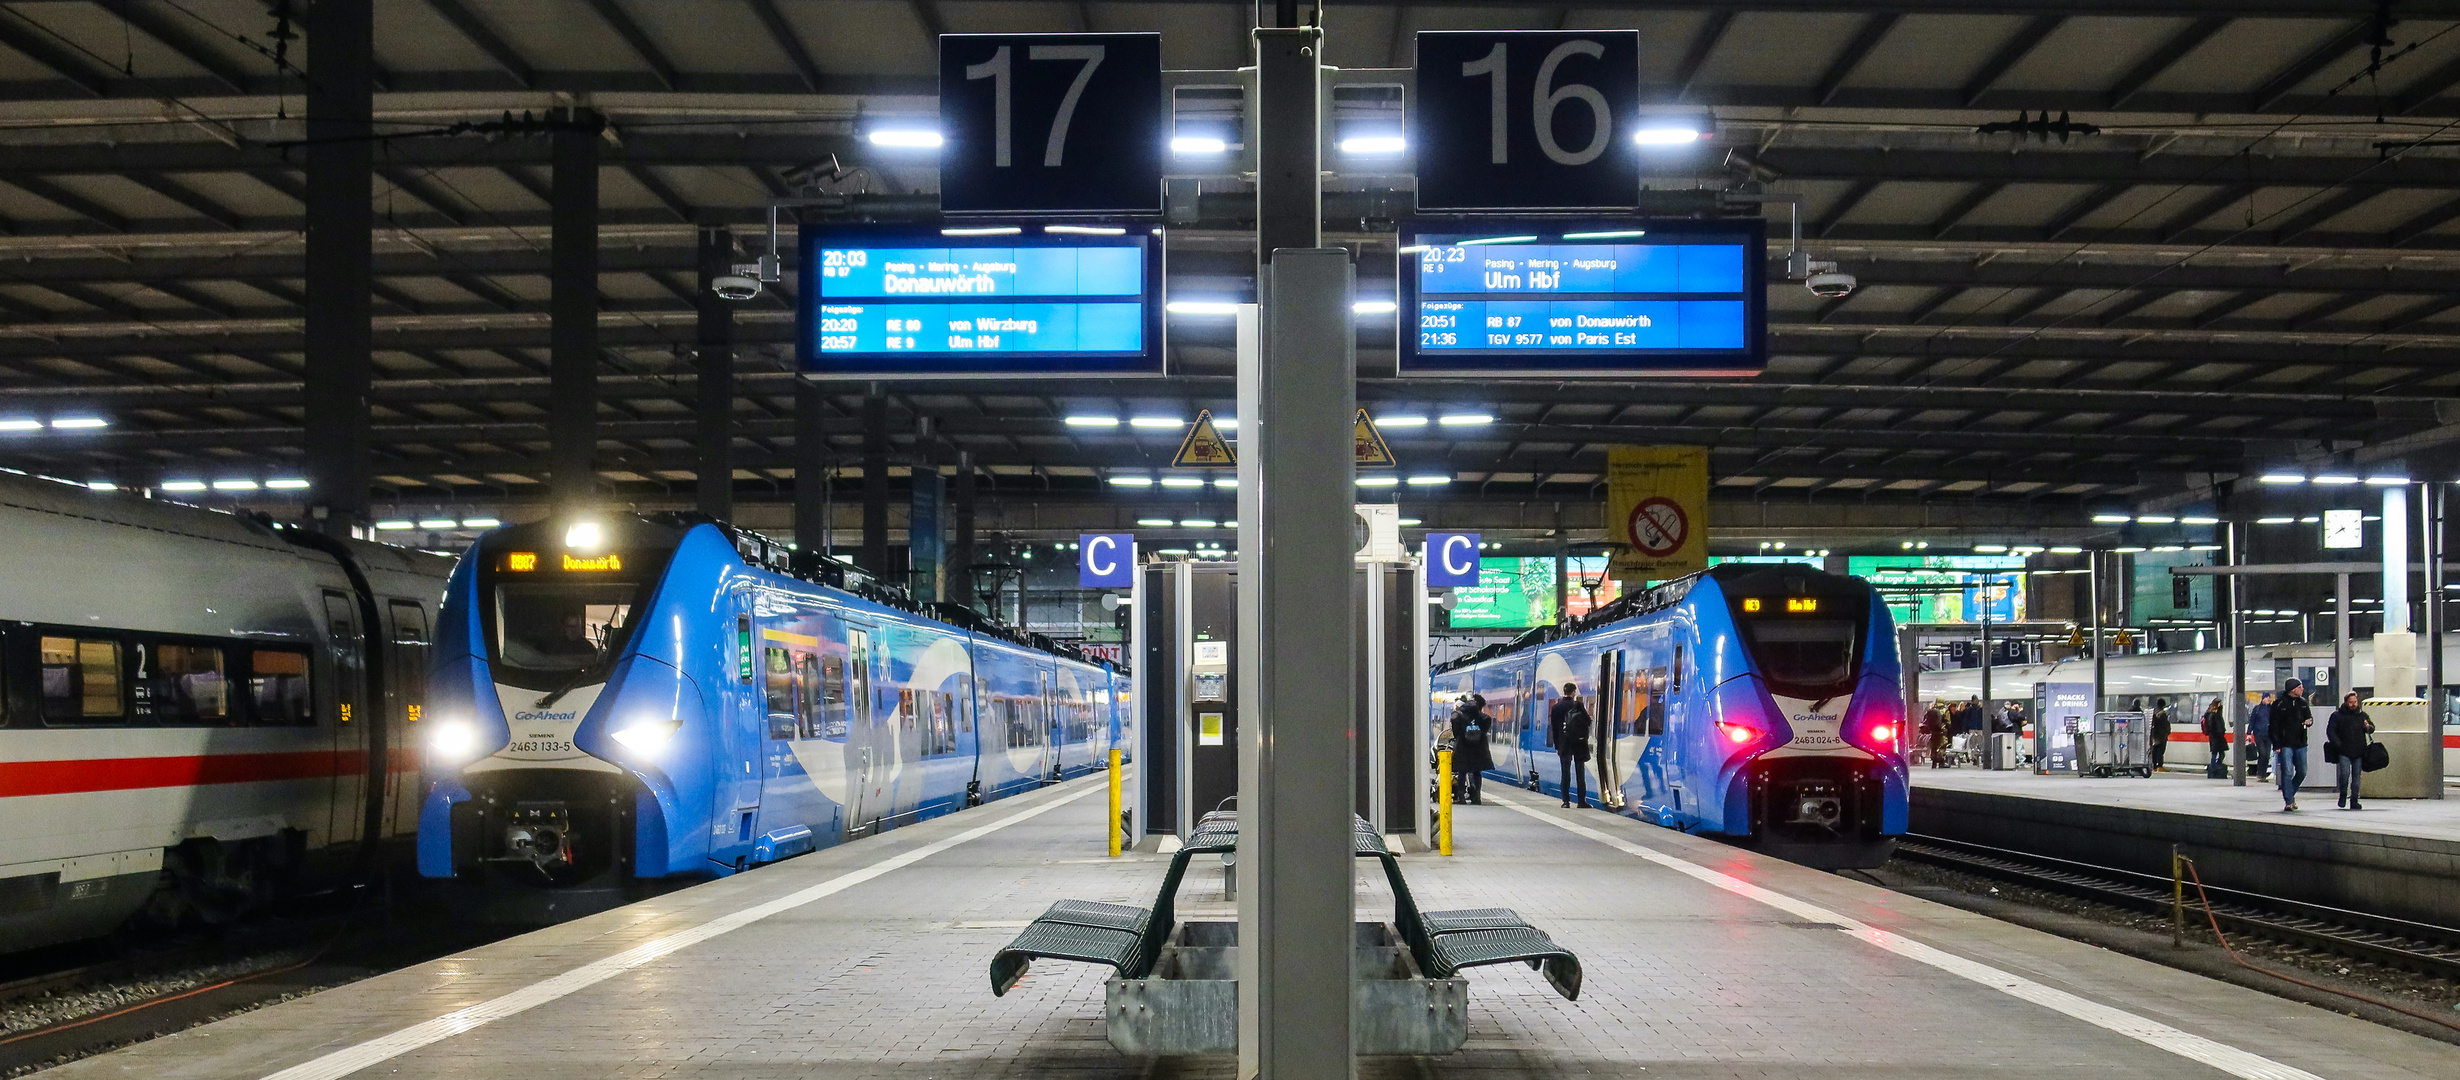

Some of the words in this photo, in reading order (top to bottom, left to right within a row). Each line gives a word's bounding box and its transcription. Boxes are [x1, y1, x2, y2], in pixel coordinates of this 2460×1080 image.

[966, 45, 1105, 167] 17
[1462, 40, 1612, 165] 16
[824, 251, 866, 266] 20:03
[1423, 248, 1465, 262] 20:23
[886, 262, 915, 274] Pasing
[928, 262, 959, 274] Mering
[973, 262, 1016, 273] Augsburg
[1423, 264, 1434, 272] RE
[1438, 264, 1443, 272] 9
[1485, 259, 1514, 270] Pasing
[1528, 259, 1559, 270] Mering
[1573, 259, 1616, 270] Augsburg
[886, 272, 994, 292] Donauwörth
[1485, 272, 1520, 288] Ulm
[1530, 271, 1560, 288] Hbf
[1422, 302, 1463, 310] Folgezüge:
[822, 319, 856, 331] 20:20
[887, 320, 901, 331] RE
[906, 320, 920, 331] 80
[949, 321, 971, 330] von
[977, 318, 1036, 333] Würzburg
[1422, 316, 1455, 327] 20:51
[1487, 317, 1502, 327] RB
[1507, 317, 1521, 327] 87
[1550, 318, 1572, 327] von
[1578, 315, 1651, 327] Donauwörth
[822, 336, 856, 348] 20:57
[887, 337, 901, 348] RE
[906, 337, 914, 348] 9
[949, 336, 972, 347] Ulm
[978, 336, 999, 347] Hbf
[1422, 333, 1456, 344] 21:36
[1488, 334, 1510, 344] TGV
[1516, 334, 1542, 344] 9577
[1550, 336, 1572, 344] von
[1578, 333, 1609, 344] Paris
[1616, 333, 1636, 344] Est
[1087, 536, 1116, 576] C
[1443, 535, 1473, 575] C
[510, 555, 535, 570] RB87
[563, 555, 621, 570] Donauwörth
[1493, 576, 1511, 584] Saat
[1468, 585, 1510, 593] Schokolade
[1745, 599, 1760, 611] RE9
[1953, 644, 1964, 657] B
[2009, 643, 2020, 657] B
[137, 644, 147, 678] 2
[515, 711, 576, 720] Go-Ahead
[1793, 713, 1838, 721] Go-Ahead
[511, 742, 538, 752] 2463
[541, 741, 571, 752] 133-5
